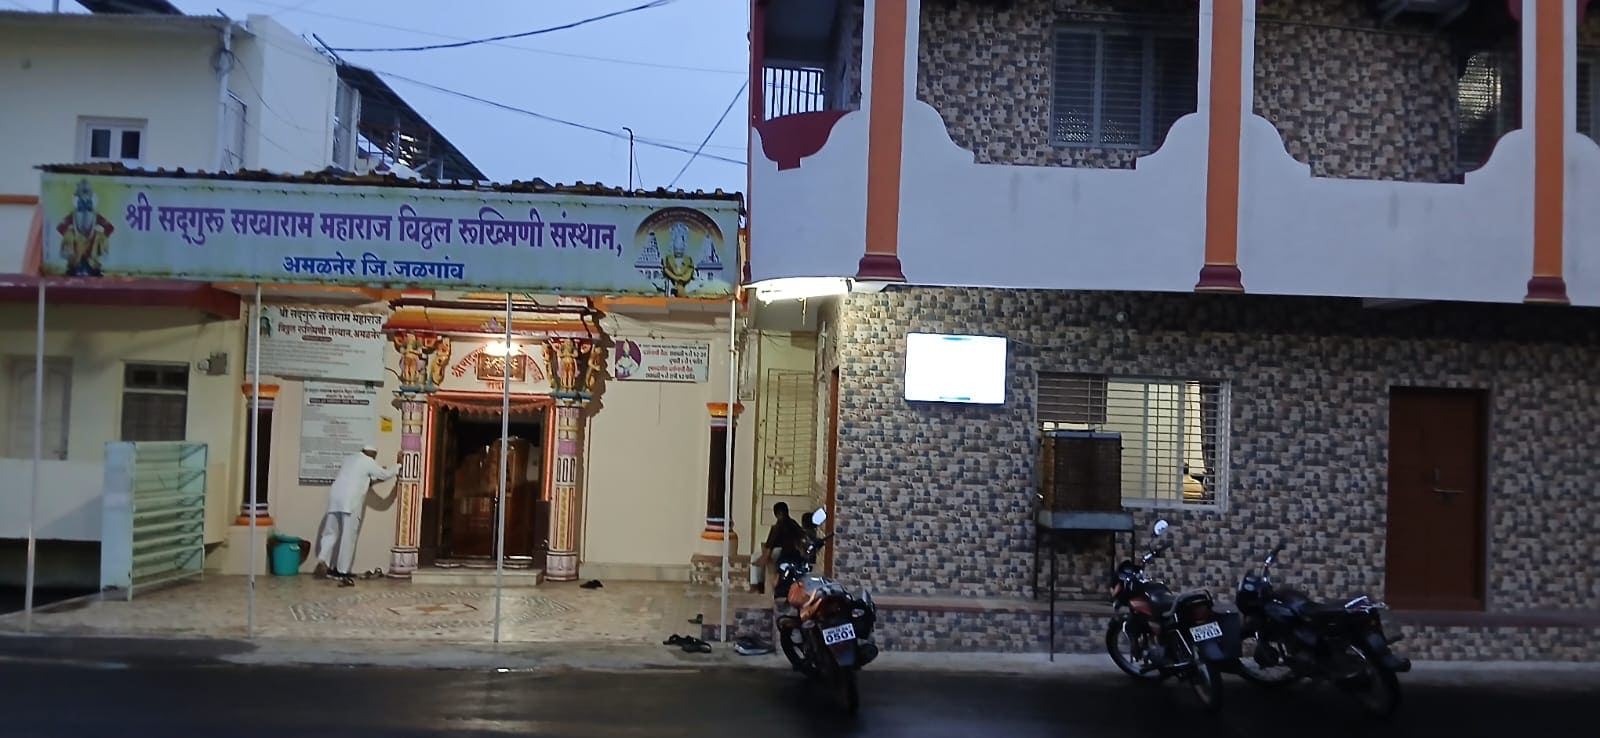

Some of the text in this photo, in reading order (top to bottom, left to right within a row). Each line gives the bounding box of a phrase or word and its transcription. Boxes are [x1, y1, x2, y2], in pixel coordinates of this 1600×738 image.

[126, 191, 152, 231] श्री
[231, 208, 314, 239] सखाराम
[320, 212, 393, 242] महाराज
[398, 204, 453, 250] विठ्ठल
[283, 251, 356, 276] अमळनेर
[826, 629, 854, 643] 0501
